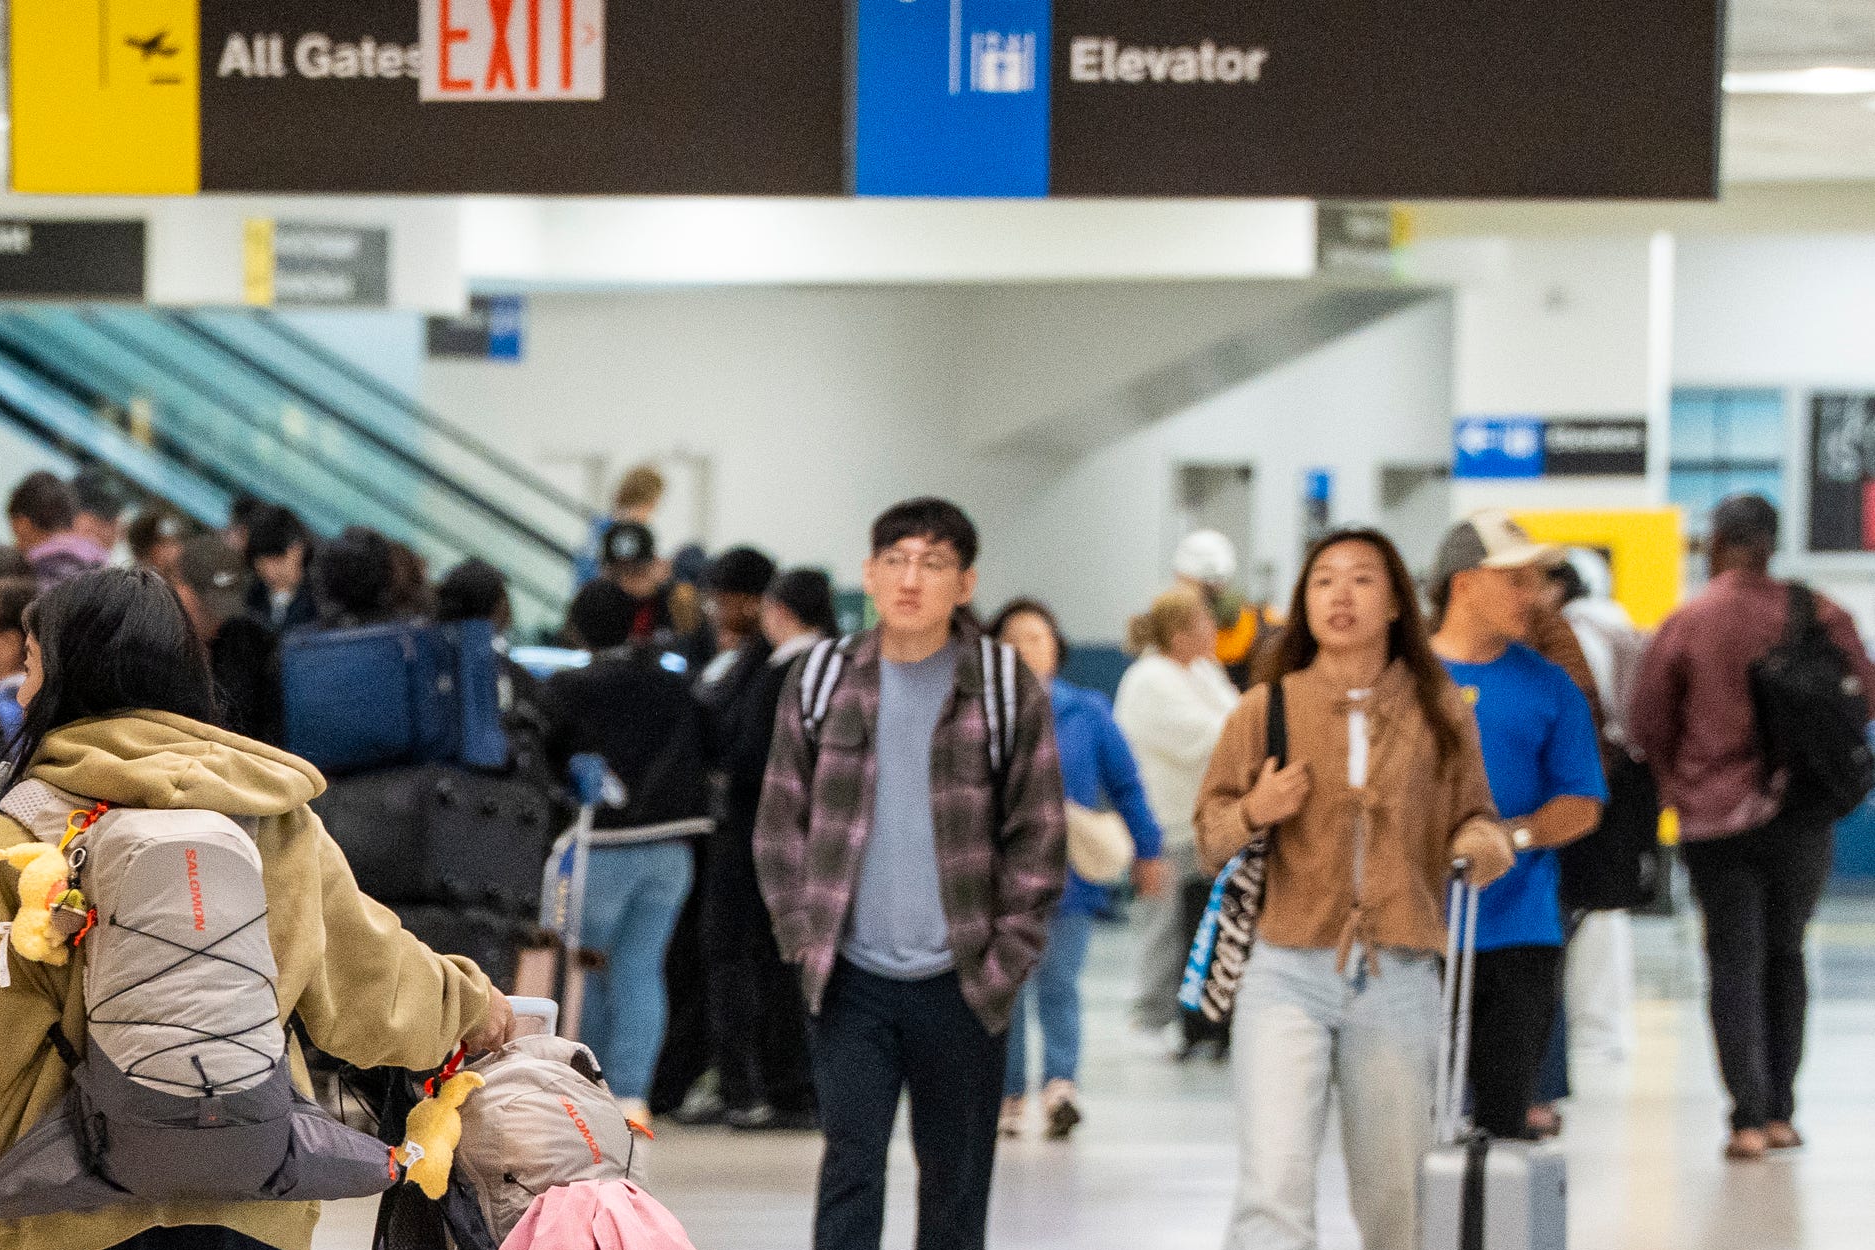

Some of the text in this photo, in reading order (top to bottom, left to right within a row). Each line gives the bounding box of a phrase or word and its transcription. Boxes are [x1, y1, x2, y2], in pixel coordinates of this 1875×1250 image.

[218, 33, 285, 78] All
[1070, 36, 1269, 82] Elevator
[185, 848, 205, 931] SALOMON
